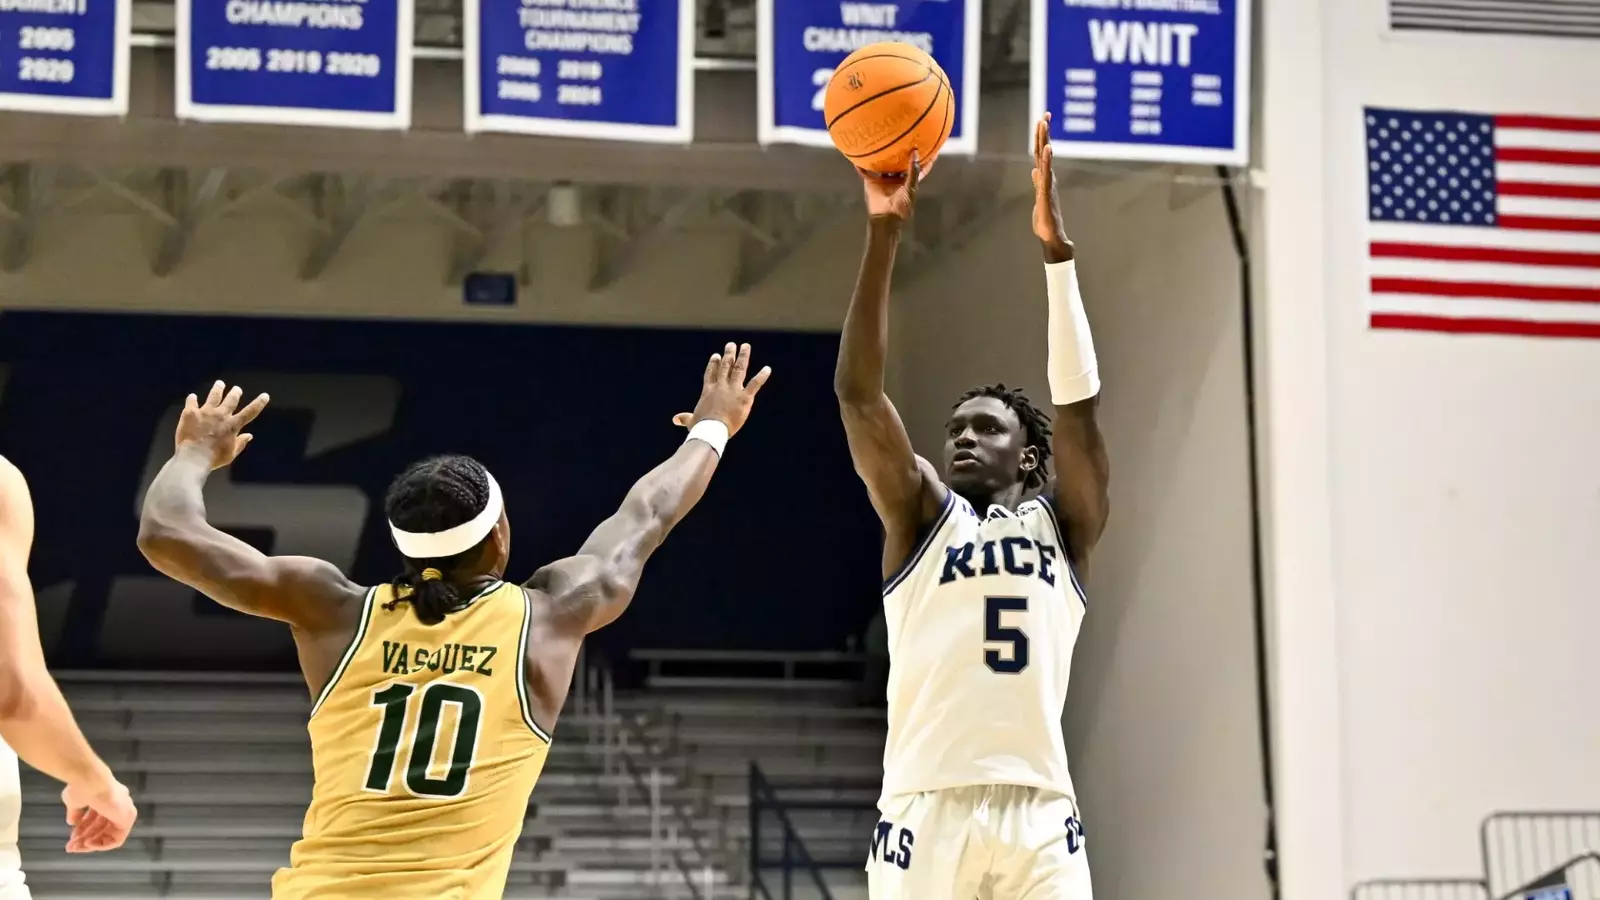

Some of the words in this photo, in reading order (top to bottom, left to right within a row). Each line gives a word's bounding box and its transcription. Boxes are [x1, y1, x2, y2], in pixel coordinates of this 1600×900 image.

[226, 2, 364, 30] CHAMPIONS
[1088, 19, 1199, 67] WNIT
[938, 536, 1057, 588] RICE
[382, 641, 498, 677] VASQUEZ
[983, 595, 1029, 675] 5
[361, 680, 485, 799] 10
